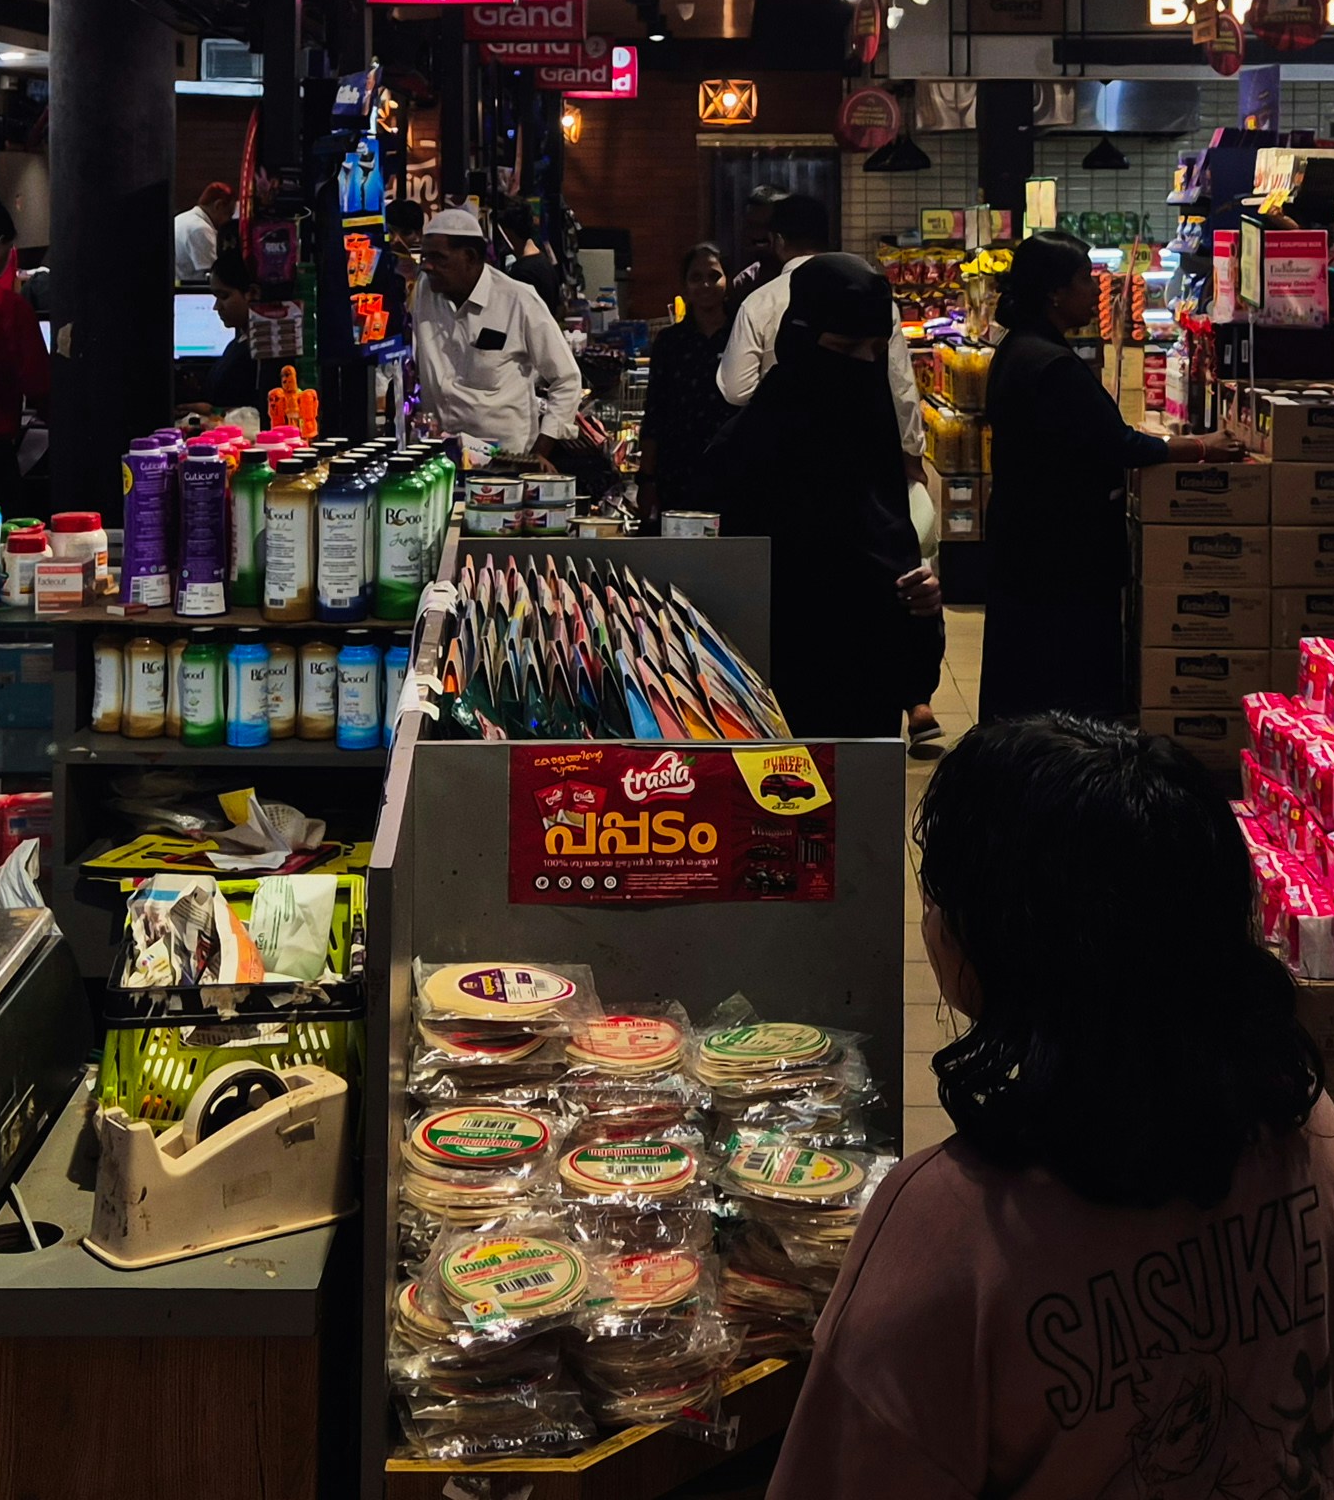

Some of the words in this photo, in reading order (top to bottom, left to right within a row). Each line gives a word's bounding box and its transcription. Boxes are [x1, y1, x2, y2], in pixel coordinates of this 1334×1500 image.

[472, 0, 573, 28] Grand
[539, 64, 608, 84] Grand
[183, 470, 221, 483] Cuticura
[620, 750, 696, 802] trasta
[772, 763, 802, 774] PRIZE
[544, 810, 718, 855] പപ്പടം
[1025, 1184, 1327, 1431] SASUKE
